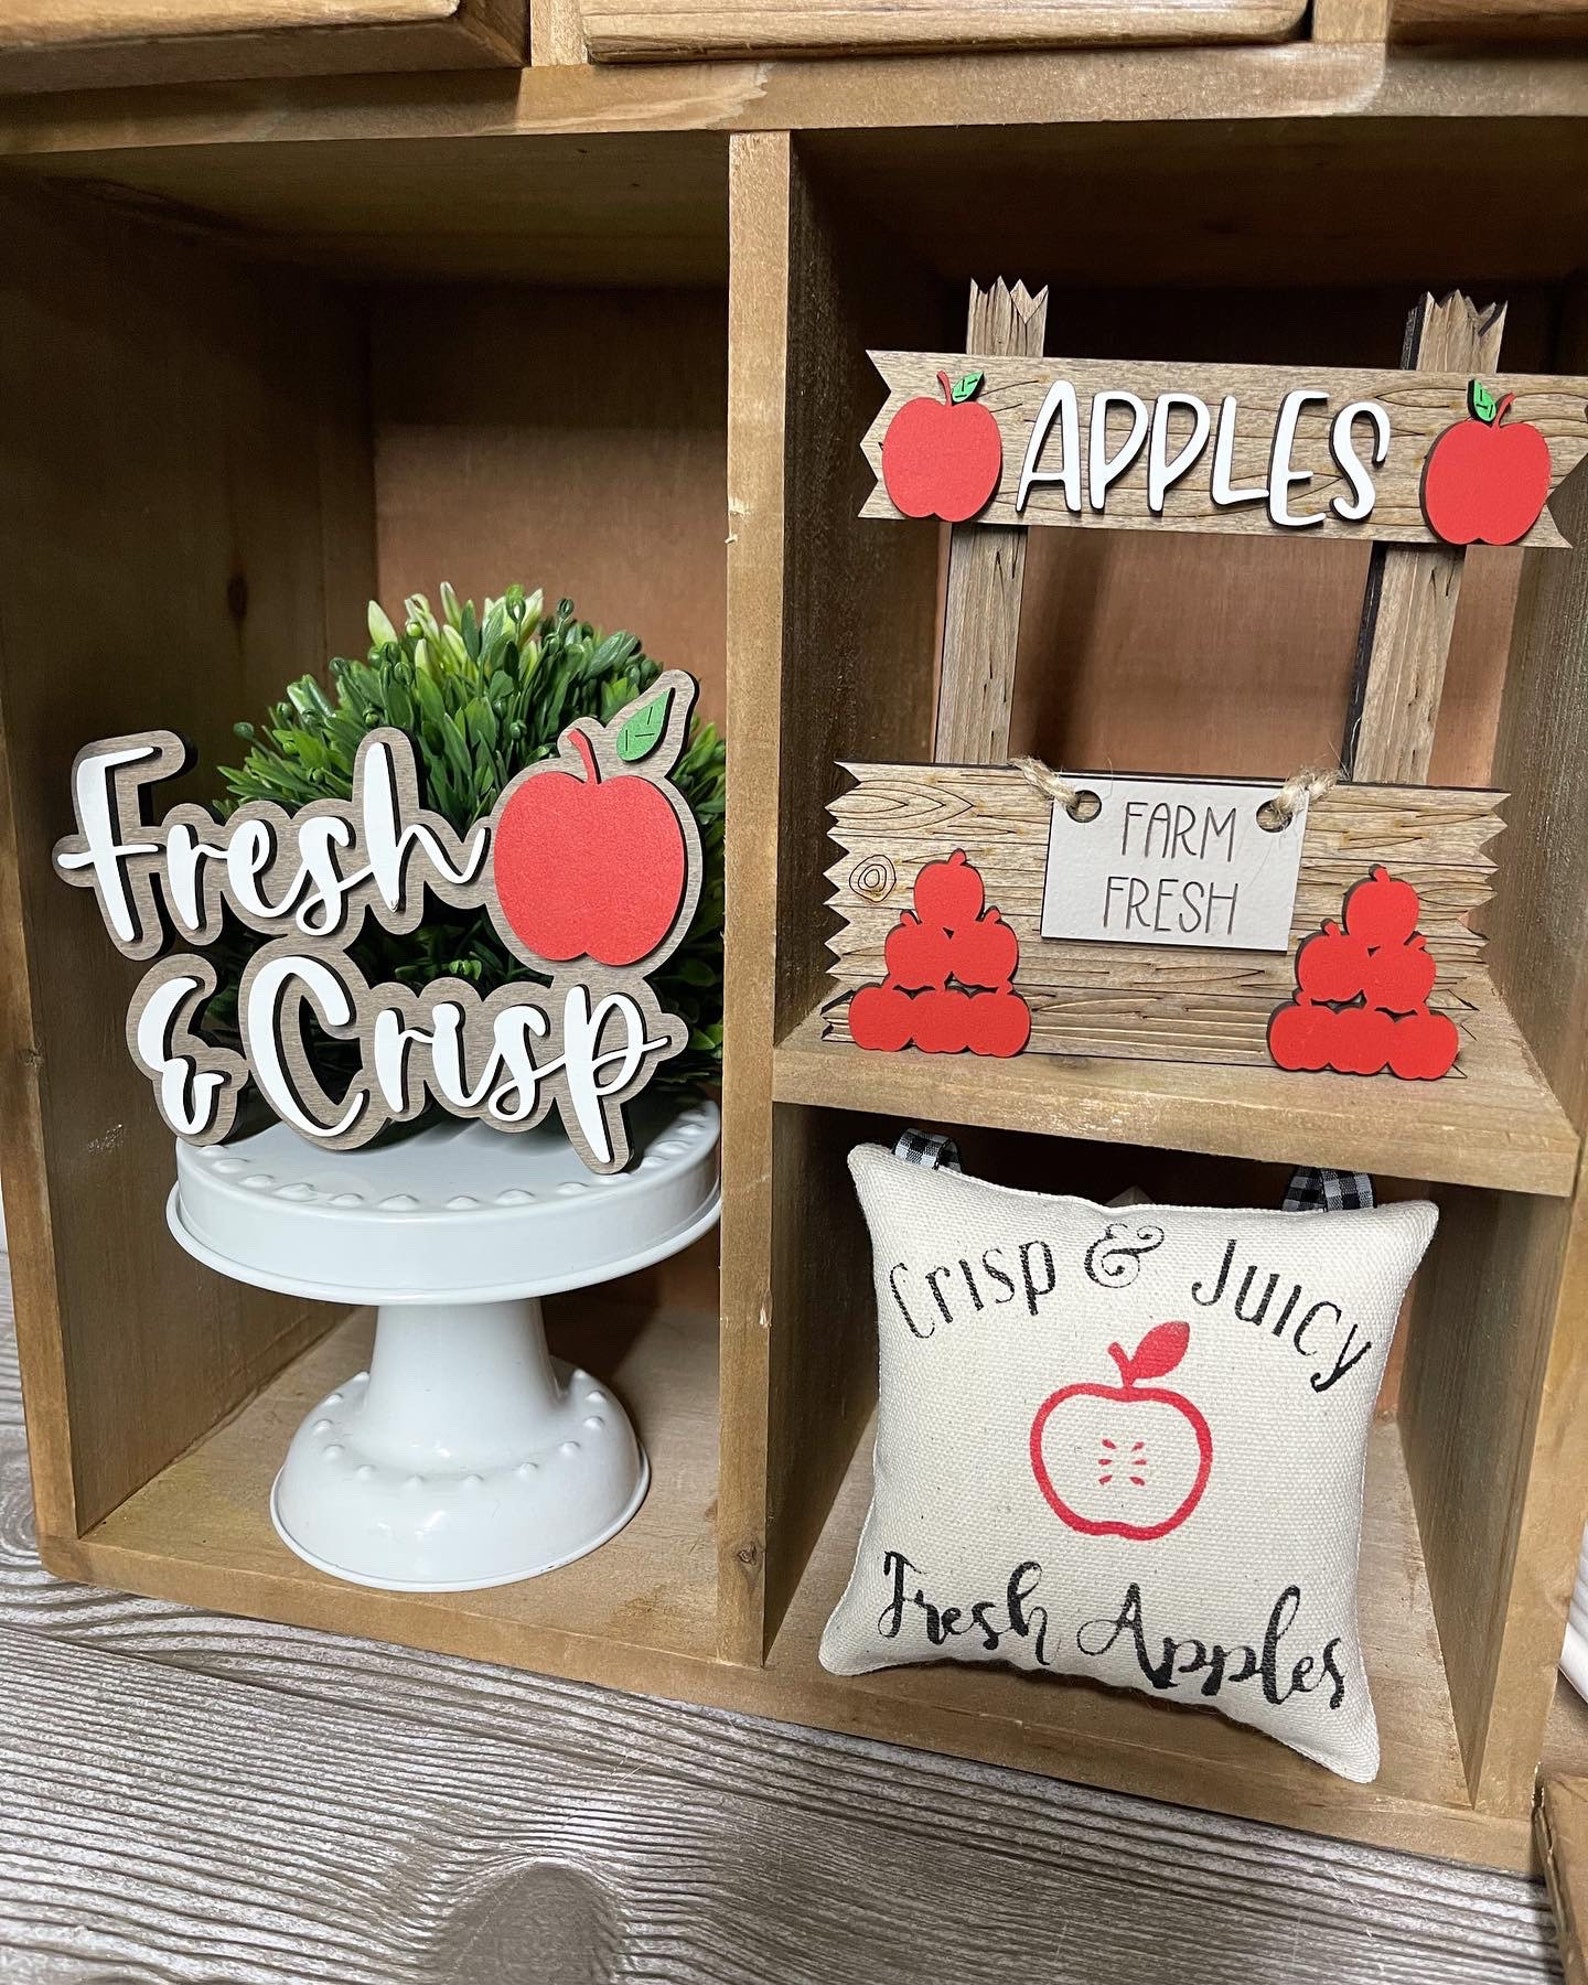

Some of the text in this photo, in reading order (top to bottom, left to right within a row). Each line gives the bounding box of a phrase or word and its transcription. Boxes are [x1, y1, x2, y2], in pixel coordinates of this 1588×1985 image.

[1015, 379, 1392, 528] APPLES
[57, 742, 491, 942] Fresh
[1103, 876, 1239, 935] FRESH
[1121, 801, 1237, 862] FARM
[137, 954, 669, 1164] & Crisp
[889, 1222, 1372, 1394] Crisp & Juicy
[878, 1550, 1346, 1711] Fresh Apples
